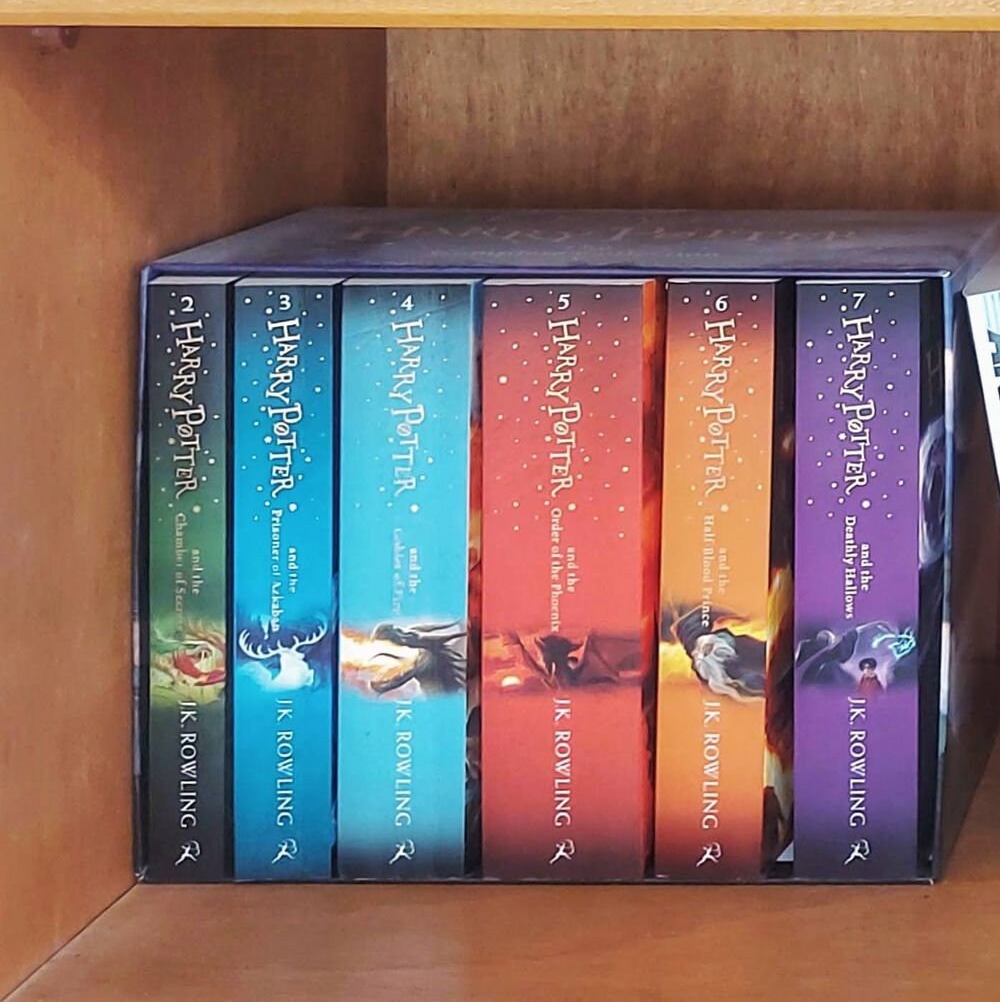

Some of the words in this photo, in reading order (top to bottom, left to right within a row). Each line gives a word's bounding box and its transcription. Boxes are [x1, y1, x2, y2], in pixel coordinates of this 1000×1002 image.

[180, 296, 195, 312] 2
[279, 294, 291, 310] 3
[400, 295, 415, 311] 4
[557, 294, 571, 310] 5
[715, 295, 728, 312] 6
[852, 293, 865, 310] 7
[169, 319, 204, 405] HARRY
[266, 318, 300, 404] HARRY
[388, 318, 424, 404] HARRY
[545, 317, 580, 403] HARRY
[701, 318, 736, 404] HARRY
[840, 315, 874, 401] HARRY
[271, 509, 283, 561] Prisoner
[551, 508, 564, 543] Order
[551, 545, 563, 559] of
[842, 515, 857, 566] Deathly
[191, 549, 204, 571] and
[288, 548, 298, 569] and
[409, 548, 421, 571] and
[567, 547, 579, 570] and
[718, 548, 730, 570] and
[861, 543, 873, 567] and
[551, 560, 563, 581] the
[567, 572, 580, 593] the
[861, 569, 873, 592] the
[191, 575, 204, 595] the
[288, 573, 298, 593] the
[409, 573, 421, 594] the
[718, 572, 730, 594] the
[844, 568, 857, 620] Hallows
[551, 583, 563, 632] Phoenix
[702, 587, 714, 627] Prince
[847, 696, 866, 726] J.K.
[180, 733, 198, 828] ROWLING
[276, 730, 294, 826] ROWLING
[395, 731, 412, 827] ROWLING
[554, 730, 572, 827] ROWLING
[702, 733, 721, 830] ROWLING
[849, 730, 867, 828] ROWLING
